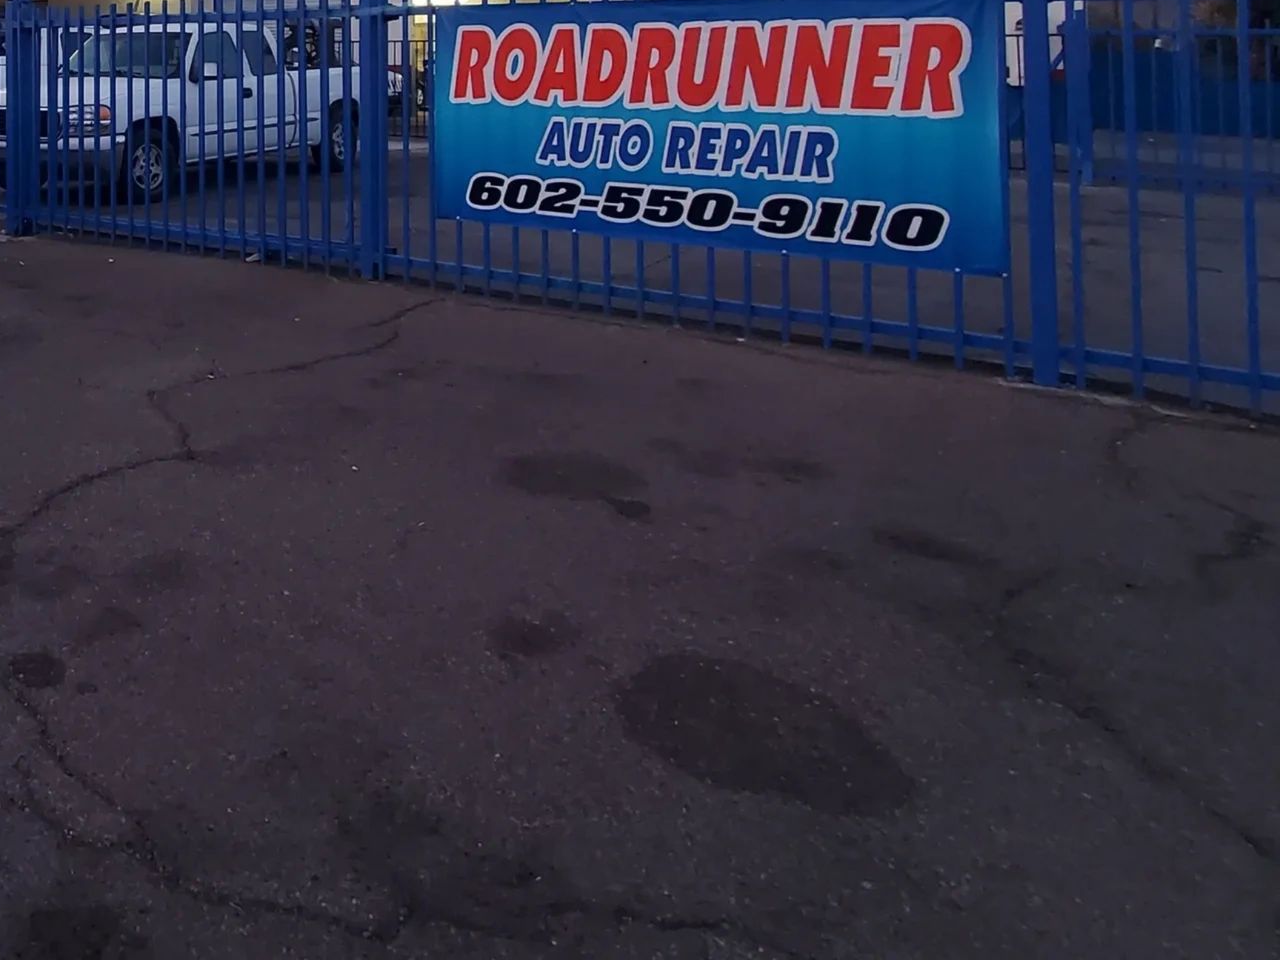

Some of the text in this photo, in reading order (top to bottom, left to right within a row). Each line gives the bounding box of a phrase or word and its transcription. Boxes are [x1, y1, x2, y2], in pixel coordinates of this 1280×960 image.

[451, 18, 970, 117] ROADRUNNER
[537, 117, 840, 183] AUTO REPAIR
[467, 172, 949, 251] 602-550-9110
